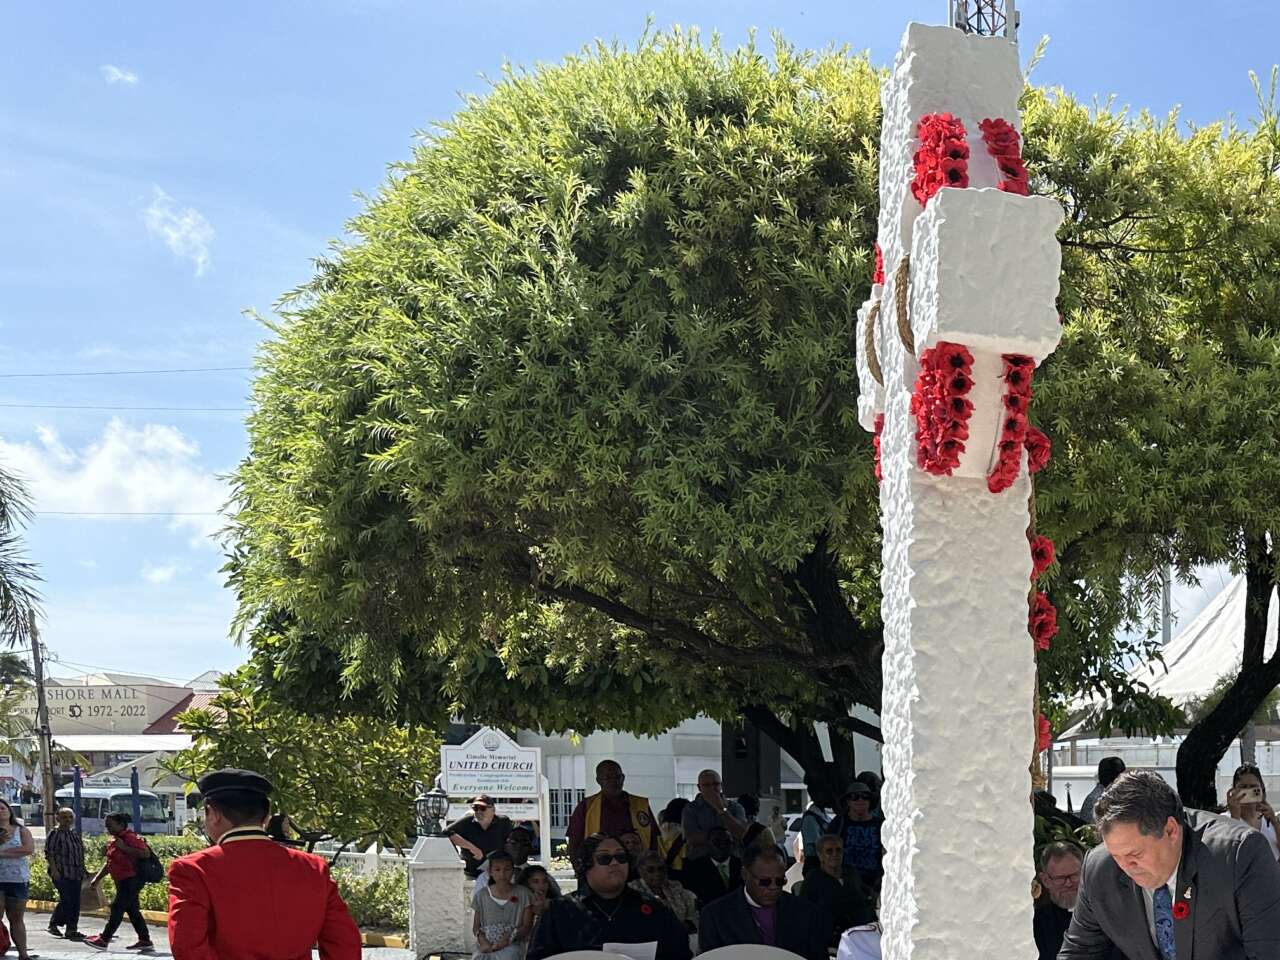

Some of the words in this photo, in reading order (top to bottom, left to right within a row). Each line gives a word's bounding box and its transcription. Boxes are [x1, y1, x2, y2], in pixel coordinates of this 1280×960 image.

[101, 688, 139, 700] MALL
[449, 761, 488, 769] UNITED
[491, 762, 533, 770] CHURCH
[453, 784, 494, 792] Everyone
